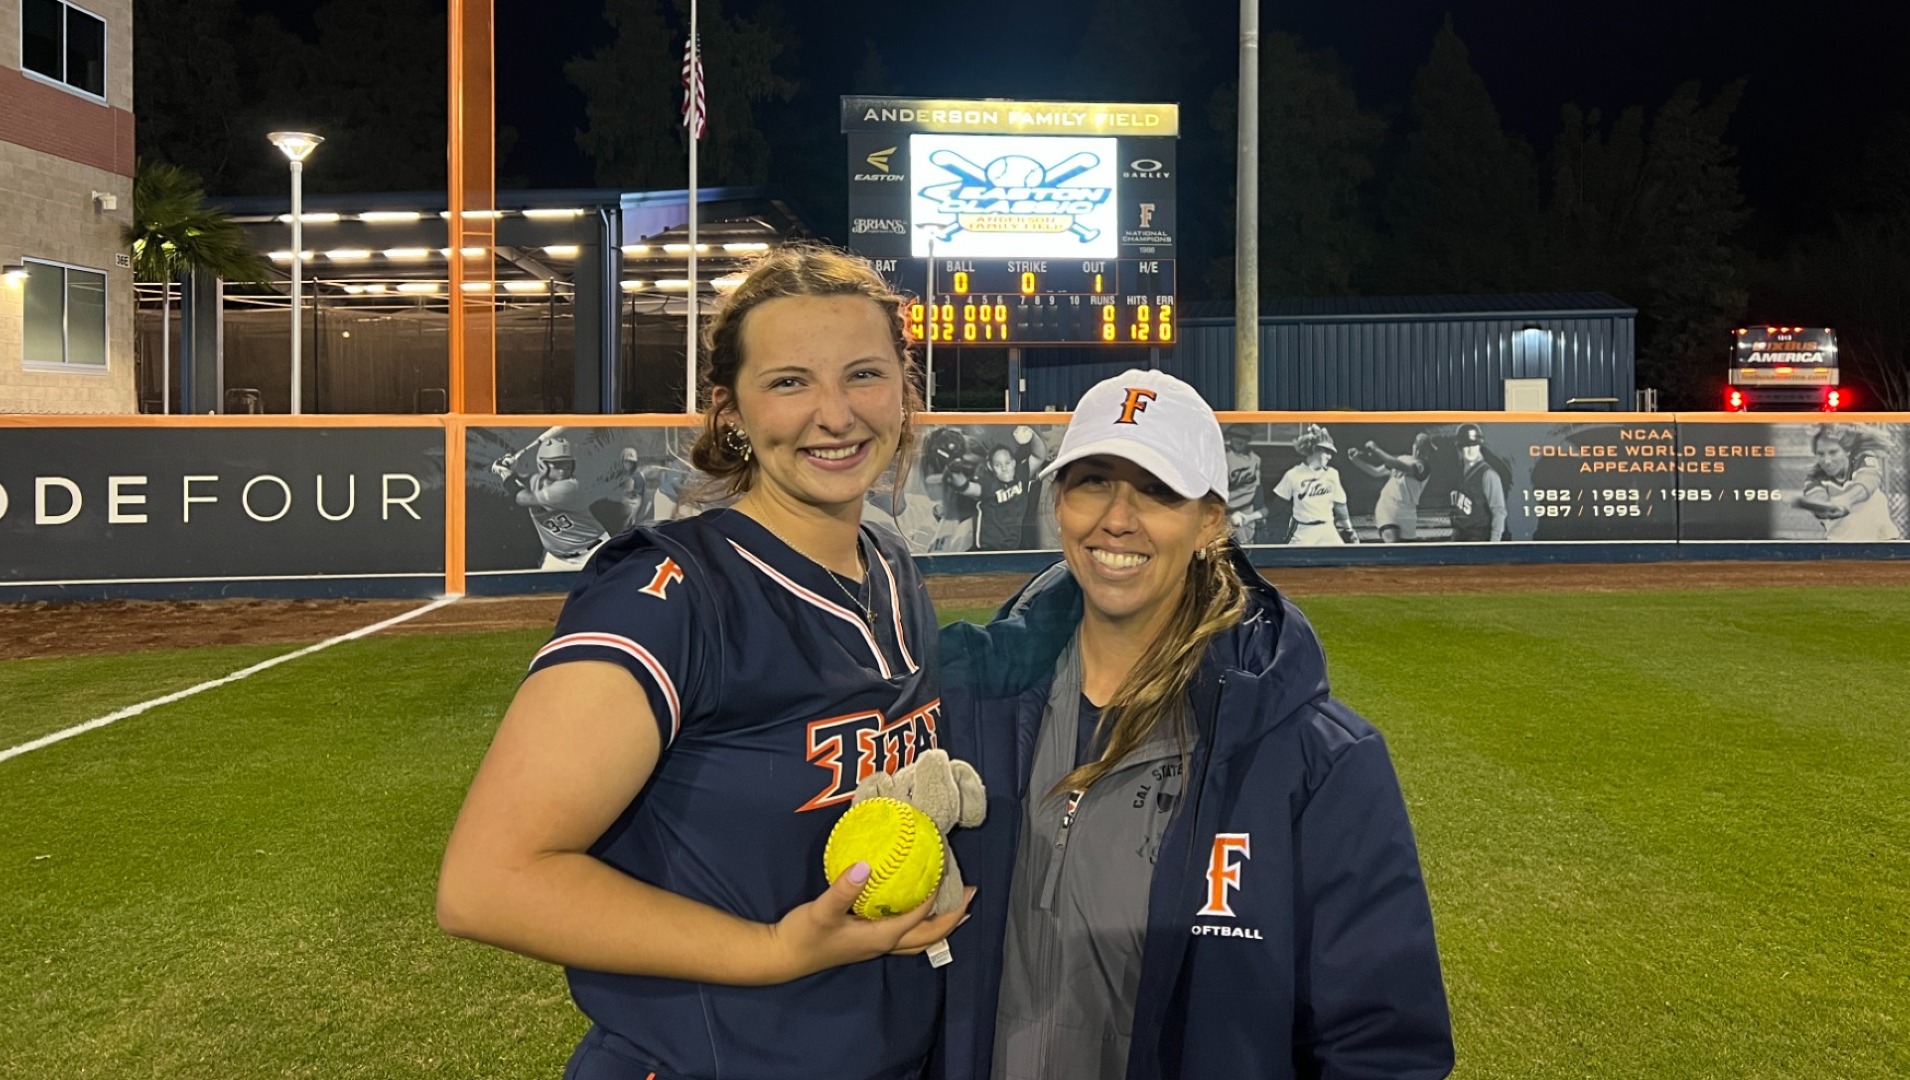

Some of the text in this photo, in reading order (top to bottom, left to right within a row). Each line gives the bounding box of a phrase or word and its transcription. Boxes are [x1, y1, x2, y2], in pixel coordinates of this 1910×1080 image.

[864, 108, 1160, 127] ANDERSON FAMILY FIELD
[1139, 203, 1155, 228] F
[875, 260, 898, 272] BAT
[946, 260, 976, 272] BALL
[1007, 261, 1047, 273] STRIKE
[1082, 261, 1106, 273] OUT
[1139, 262, 1159, 274] H/E
[954, 272, 968, 294] 0
[1021, 272, 1035, 294] 0
[1095, 273, 1103, 293] 1
[945, 295, 951, 305] 3
[966, 295, 973, 304] 4
[982, 295, 988, 304] 5
[996, 295, 1003, 304] 6
[1020, 296, 1026, 305] 7
[1034, 296, 1041, 305] 8
[1049, 296, 1055, 305] 9
[1069, 296, 1080, 305] 10
[1090, 296, 1115, 305] RUNS
[1127, 296, 1148, 305] HITS
[1156, 296, 1174, 305] ERR
[1103, 305, 1115, 322] 0
[1137, 305, 1149, 322] 0
[1159, 305, 1172, 322] 2
[1103, 323, 1115, 341] 8
[1159, 323, 1172, 341] 0
[1748, 352, 1824, 362] AMERICA
[1113, 387, 1157, 425] F
[1620, 429, 1673, 440] NCAA
[1529, 445, 1776, 457] COLLEGE WORLD SERIES
[1580, 461, 1725, 472] APPEARANCES
[0, 474, 422, 525] DE FOUR
[1523, 489, 1571, 501] 1982
[1592, 489, 1640, 501] 1983
[1660, 489, 1712, 501] 1985
[1733, 489, 1781, 501] 1986
[1523, 505, 1571, 517] 1987
[1593, 505, 1641, 517] 1995
[545, 513, 574, 534] 33
[637, 556, 685, 600] F
[1132, 763, 1184, 809] CAL STATE
[1196, 832, 1251, 918] F
[1191, 925, 1263, 940] OFTBALL
